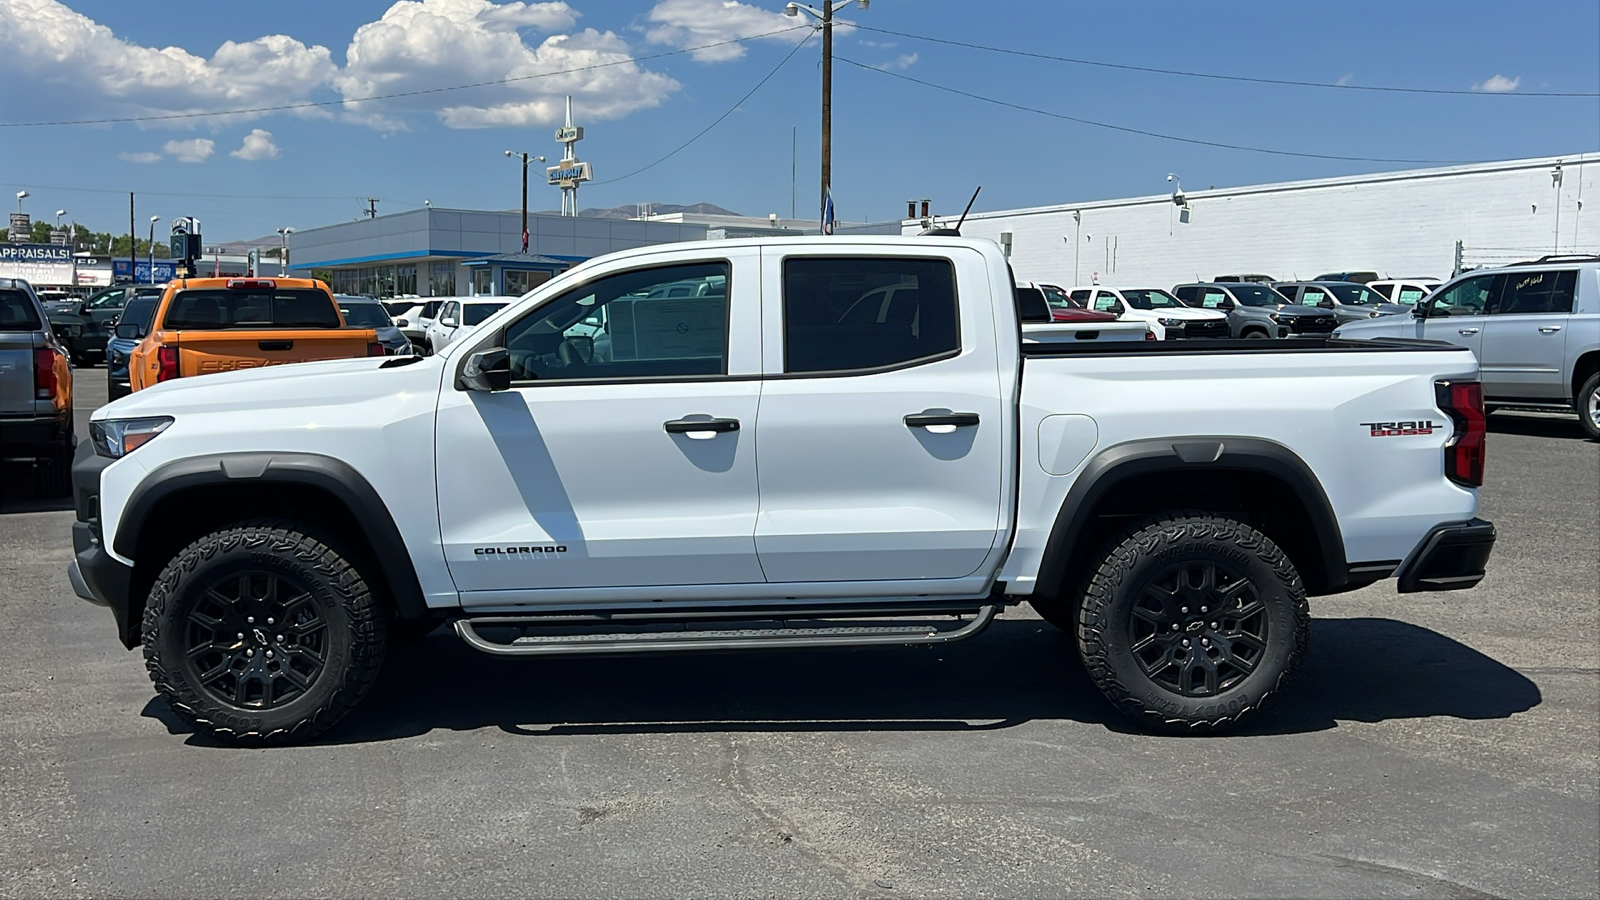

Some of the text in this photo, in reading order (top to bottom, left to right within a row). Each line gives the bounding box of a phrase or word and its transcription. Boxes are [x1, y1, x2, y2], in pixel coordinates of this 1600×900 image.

[0, 248, 70, 259] PPRAISALS!
[1360, 421, 1443, 430] TRAIL
[1371, 428, 1432, 437] BOSS
[474, 546, 567, 555] COLORADO
